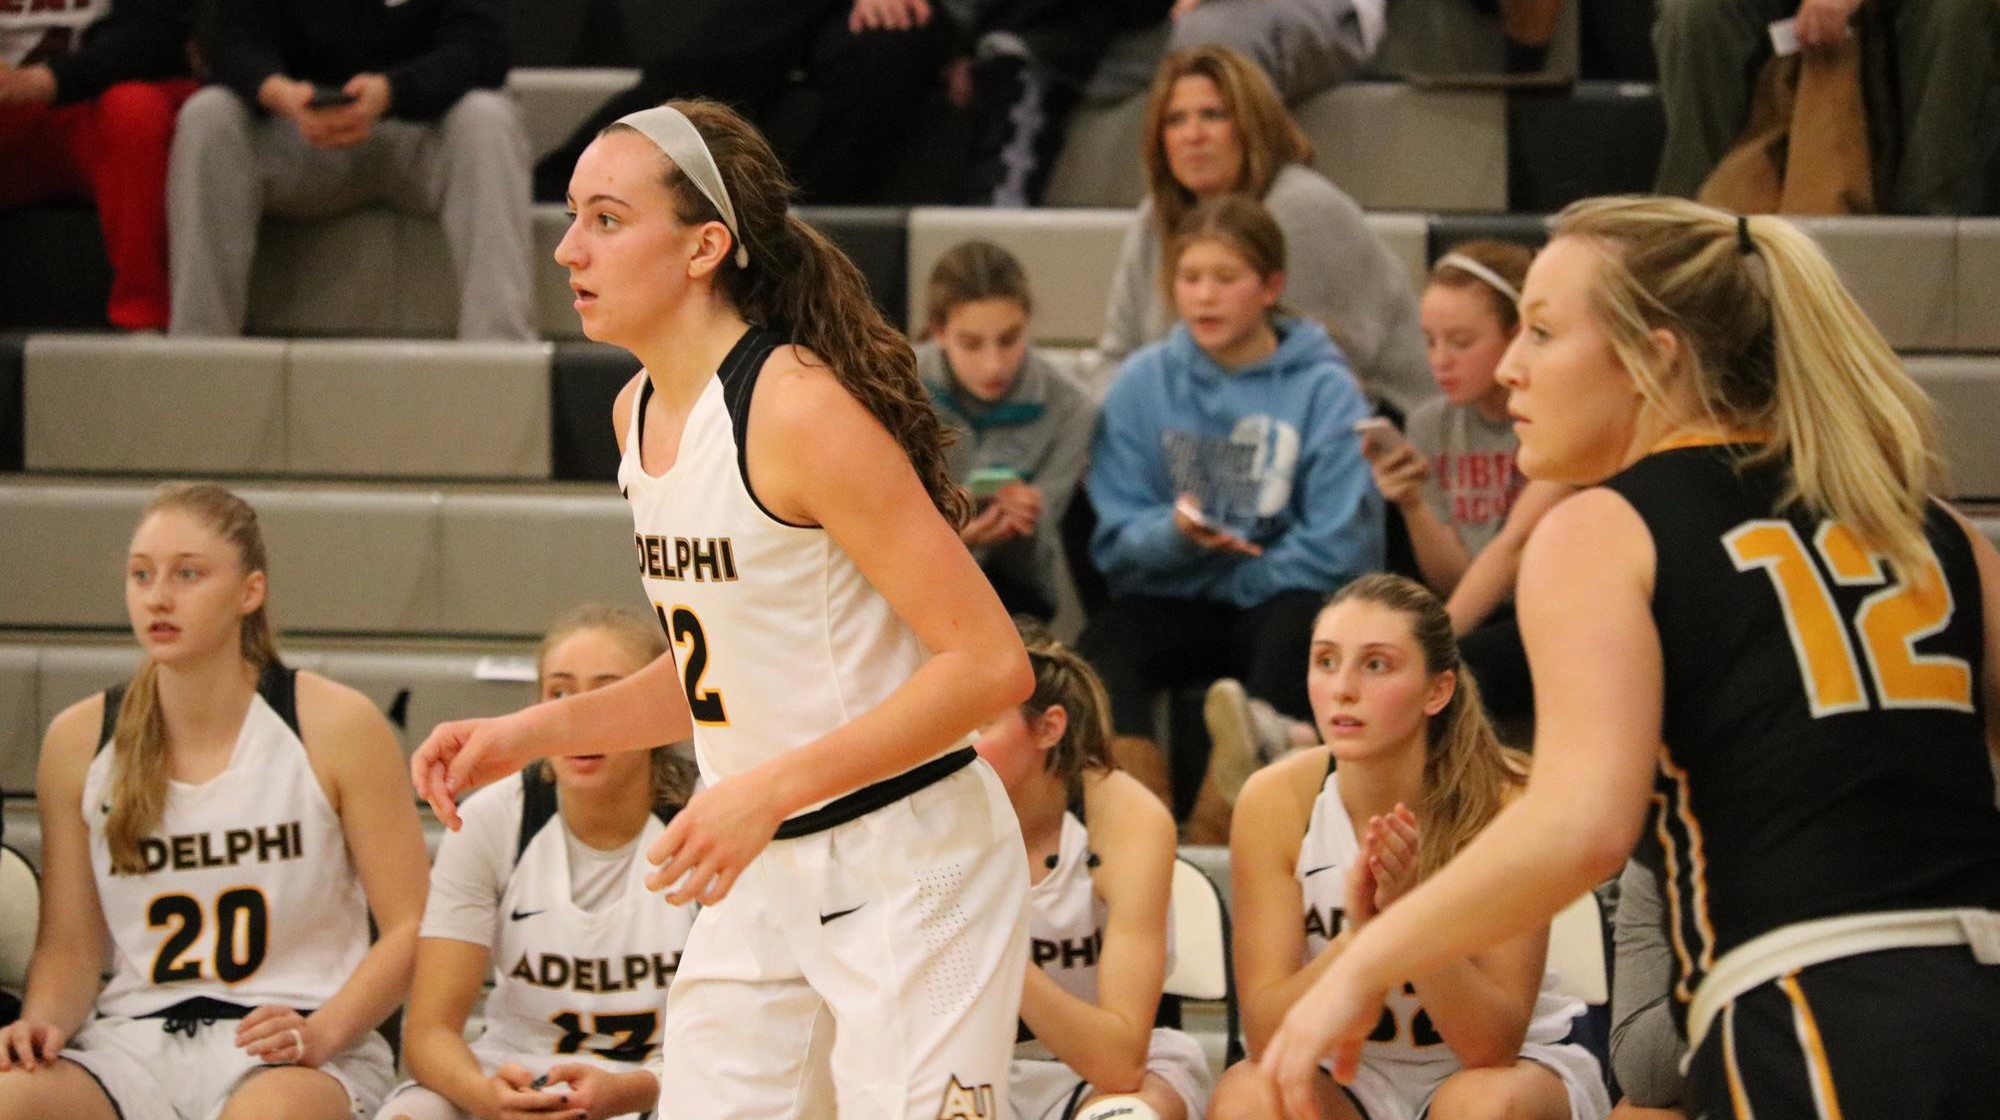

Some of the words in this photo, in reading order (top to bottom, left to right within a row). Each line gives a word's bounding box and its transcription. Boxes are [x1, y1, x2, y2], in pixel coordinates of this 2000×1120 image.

[1720, 519, 1976, 719] 12
[110, 821, 303, 877] DELPHI
[146, 885, 270, 987] 20
[510, 951, 684, 993] ADELPH
